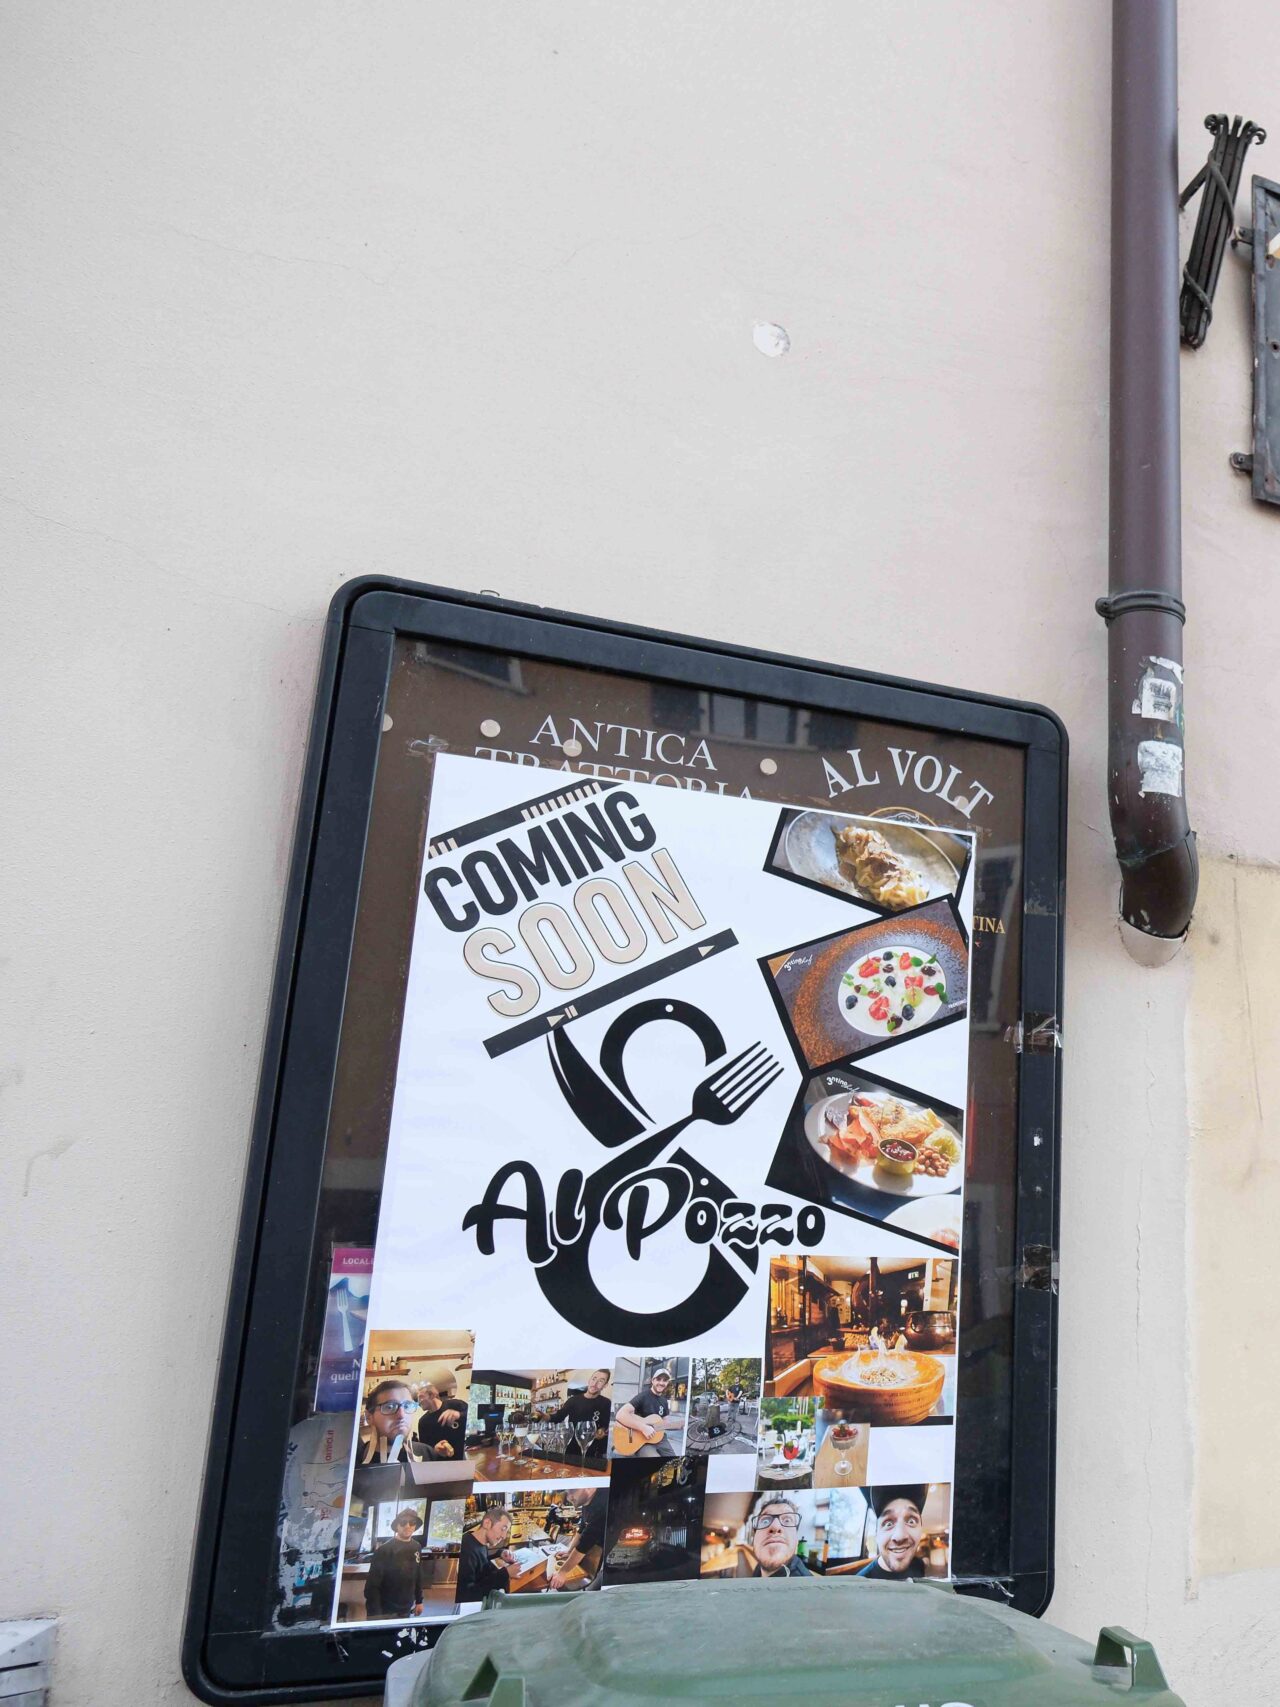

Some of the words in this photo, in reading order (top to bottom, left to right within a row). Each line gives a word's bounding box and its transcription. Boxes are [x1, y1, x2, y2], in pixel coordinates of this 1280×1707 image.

[529, 714, 718, 771] ANTICA
[821, 748, 881, 799] AL
[887, 746, 995, 820] VOLT
[424, 790, 657, 933] COMING
[462, 847, 707, 1018] SOON
